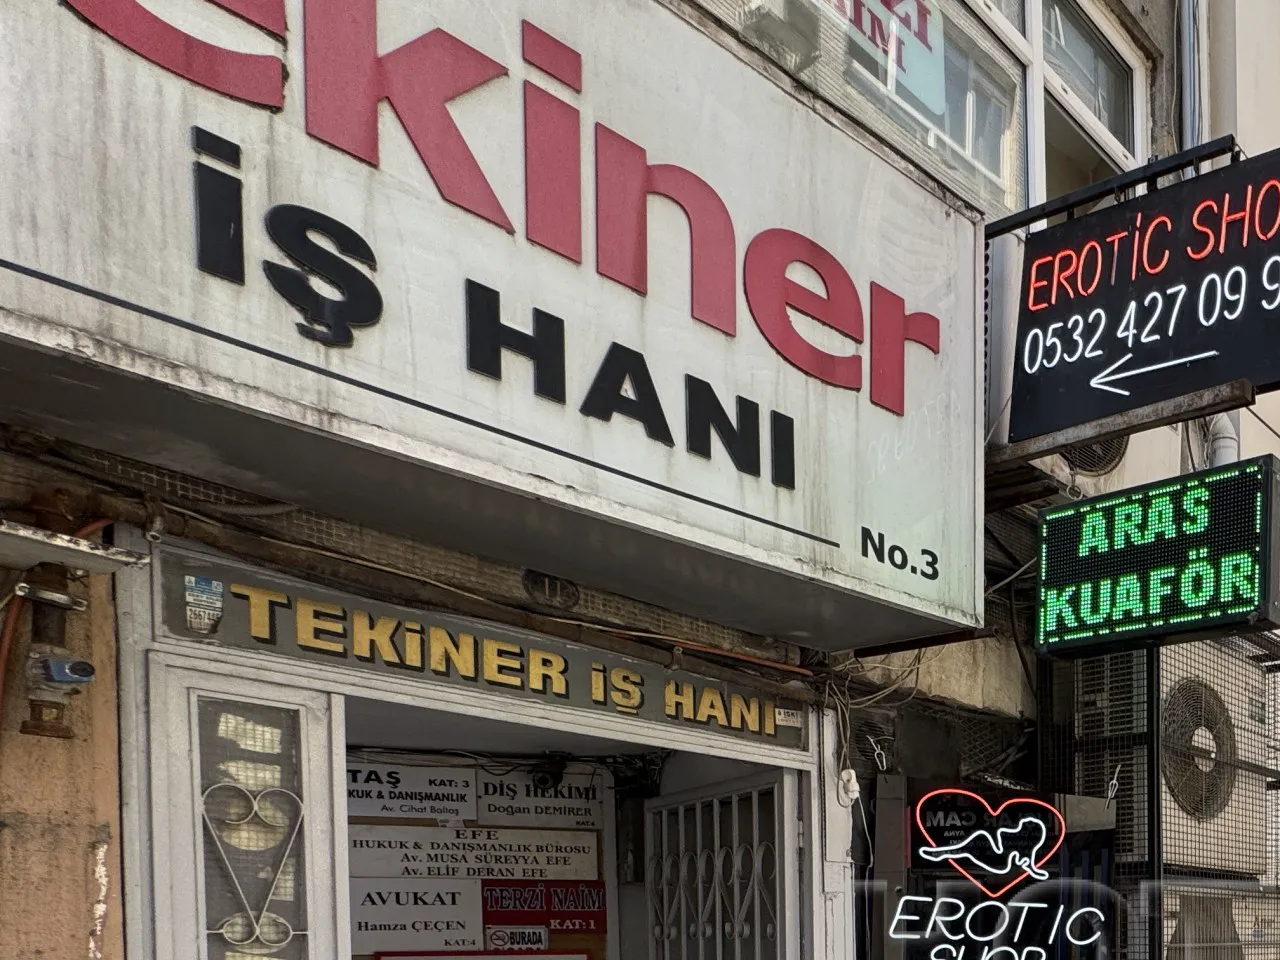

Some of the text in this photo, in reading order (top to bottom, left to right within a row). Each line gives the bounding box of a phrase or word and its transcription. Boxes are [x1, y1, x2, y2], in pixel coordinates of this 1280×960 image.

[1023, 307, 1107, 374] 0532
[1116, 284, 1187, 348] 427
[1198, 265, 1247, 326] 09
[465, 278, 796, 490] HANI
[1078, 486, 1210, 557] ARAS
[858, 524, 940, 581] No.3
[1045, 548, 1256, 632] KUAFÖR
[663, 678, 777, 736] HANI
[376, 791, 385, 800] &
[388, 791, 468, 804] DANIŞMANLIK
[482, 780, 598, 803] DİŞ HEKİMİ
[399, 804, 427, 814] Cihat
[487, 804, 593, 818] Doğan DEMİRER
[454, 829, 500, 841] EFE
[352, 839, 592, 855] HUKUK & DANIŞMANLIK BÜROSU
[400, 852, 572, 867] Av. MUSA SÜREYYA EFE
[400, 865, 548, 879] Av. ELİF DERAN EFE
[360, 891, 462, 907] AVUKAT
[483, 882, 605, 912] TERZİ NAİM
[357, 920, 467, 934] Hamza ÇEÇEN
[889, 895, 1105, 946] EROTIC
[509, 931, 544, 946] BURADA
